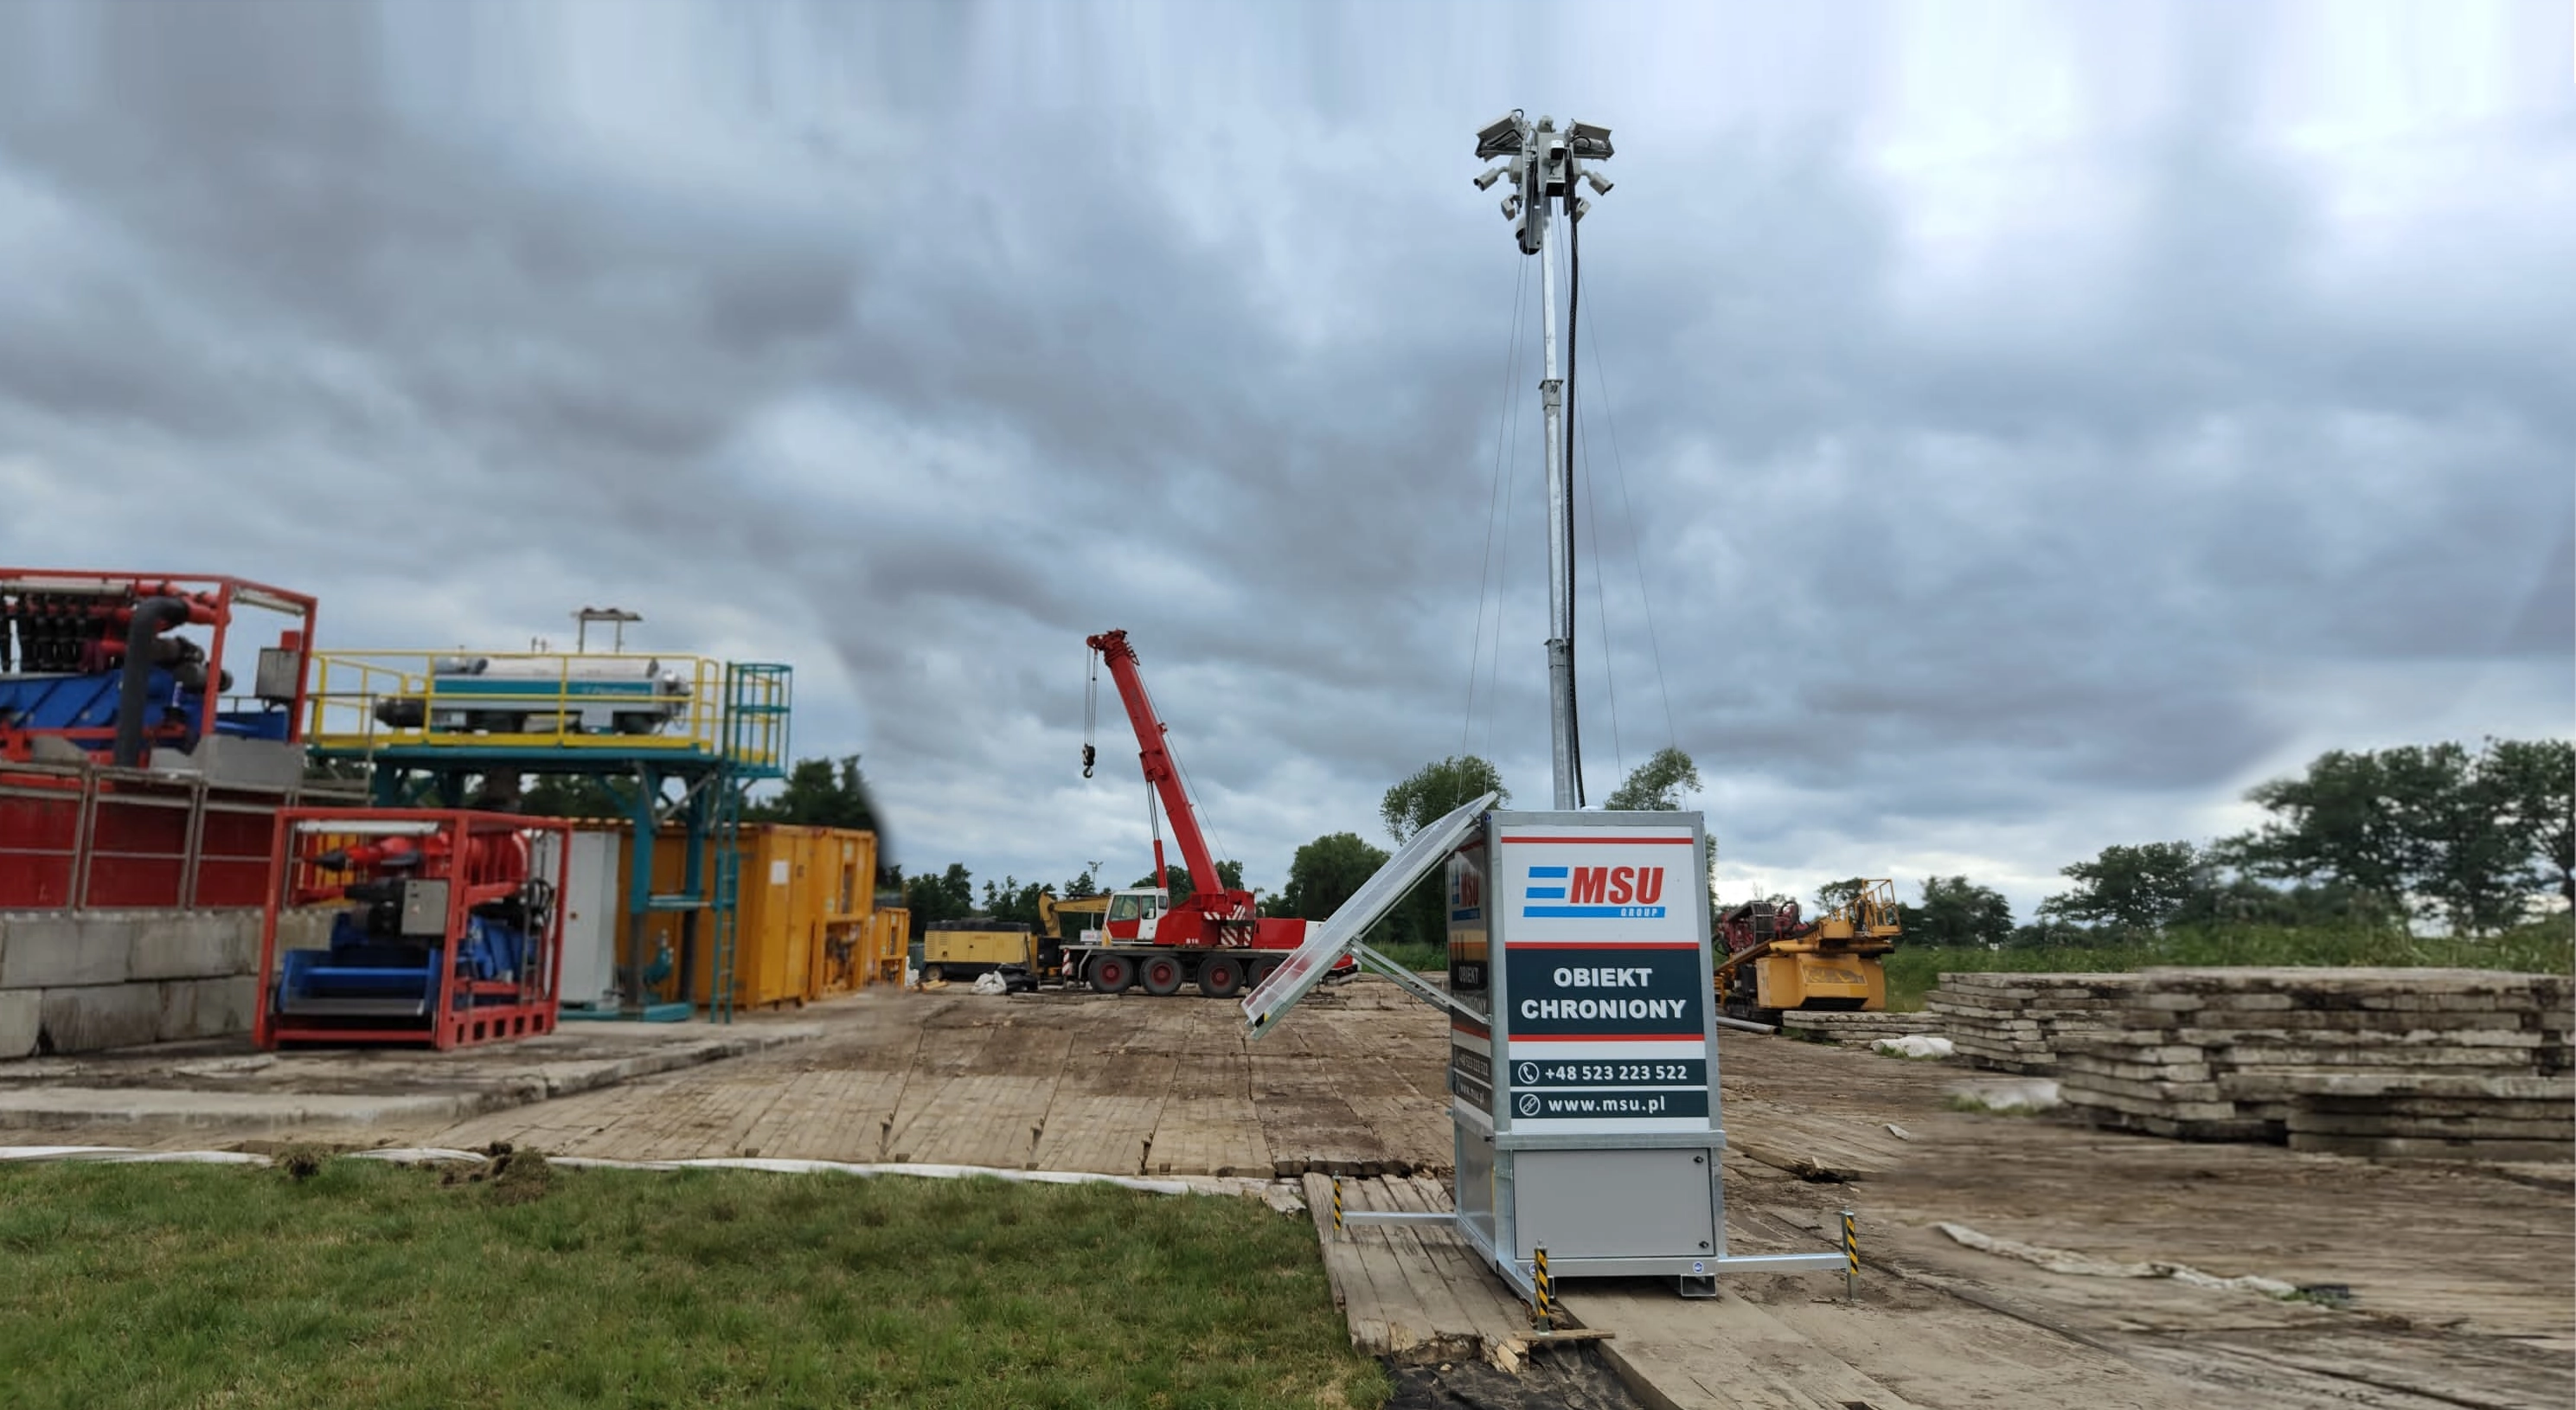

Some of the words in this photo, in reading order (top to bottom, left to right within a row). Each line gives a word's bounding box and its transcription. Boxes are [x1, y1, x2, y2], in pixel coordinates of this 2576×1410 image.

[1570, 866, 1664, 905] MSU
[1620, 907, 1658, 917] GROUP
[1554, 967, 1653, 987] OBIEKT
[1521, 999, 1687, 1019] CHRONIONY
[1545, 1065, 1577, 1080] +48
[1582, 1065, 1614, 1080] 523
[1618, 1065, 1651, 1080] 223
[1656, 1065, 1688, 1080] 522
[1548, 1095, 1666, 1114] www.msu.pl
